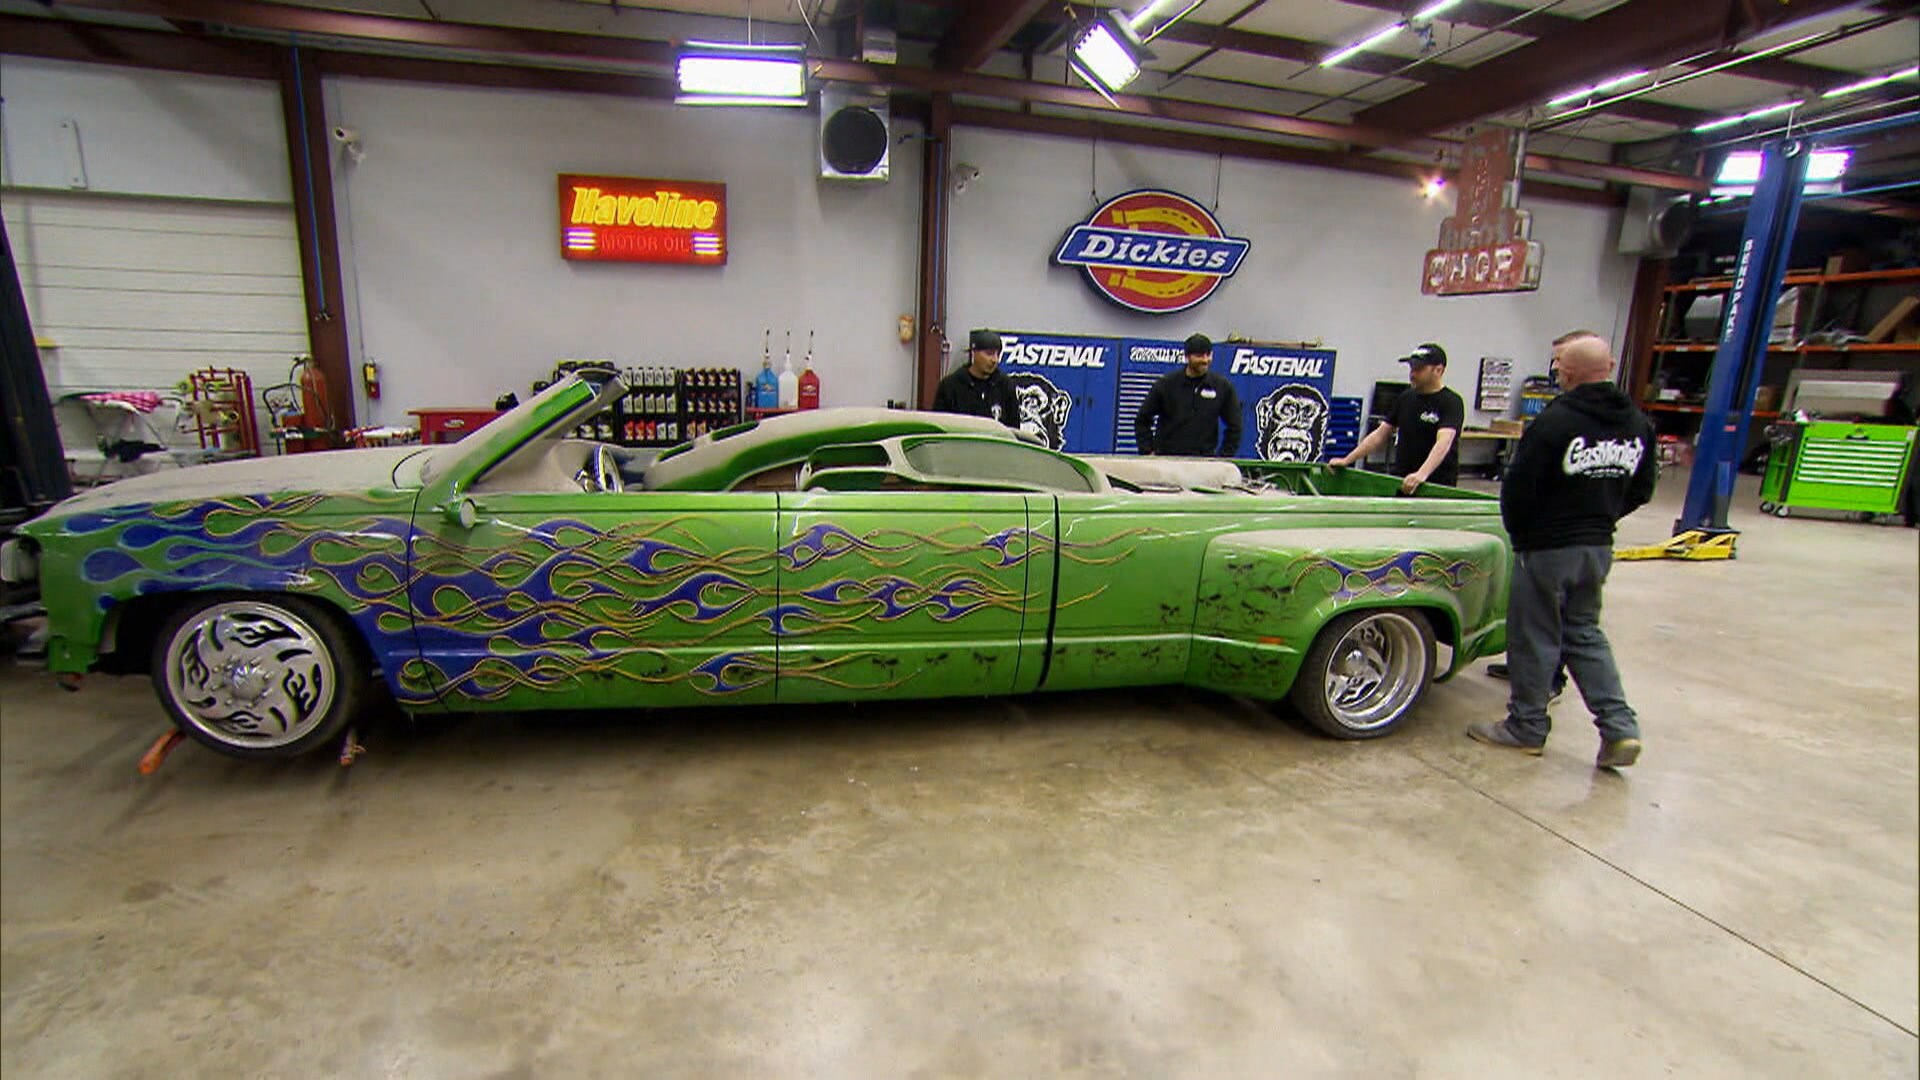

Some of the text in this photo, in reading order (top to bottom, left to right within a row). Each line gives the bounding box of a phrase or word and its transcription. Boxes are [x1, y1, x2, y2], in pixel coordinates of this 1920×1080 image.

[571, 187, 718, 229] Havoline
[601, 232, 690, 251] MOTOR OIL
[1077, 234, 1230, 268] Dickies
[999, 336, 1105, 367] FASTENAL
[1230, 349, 1325, 377] FASTENAL
